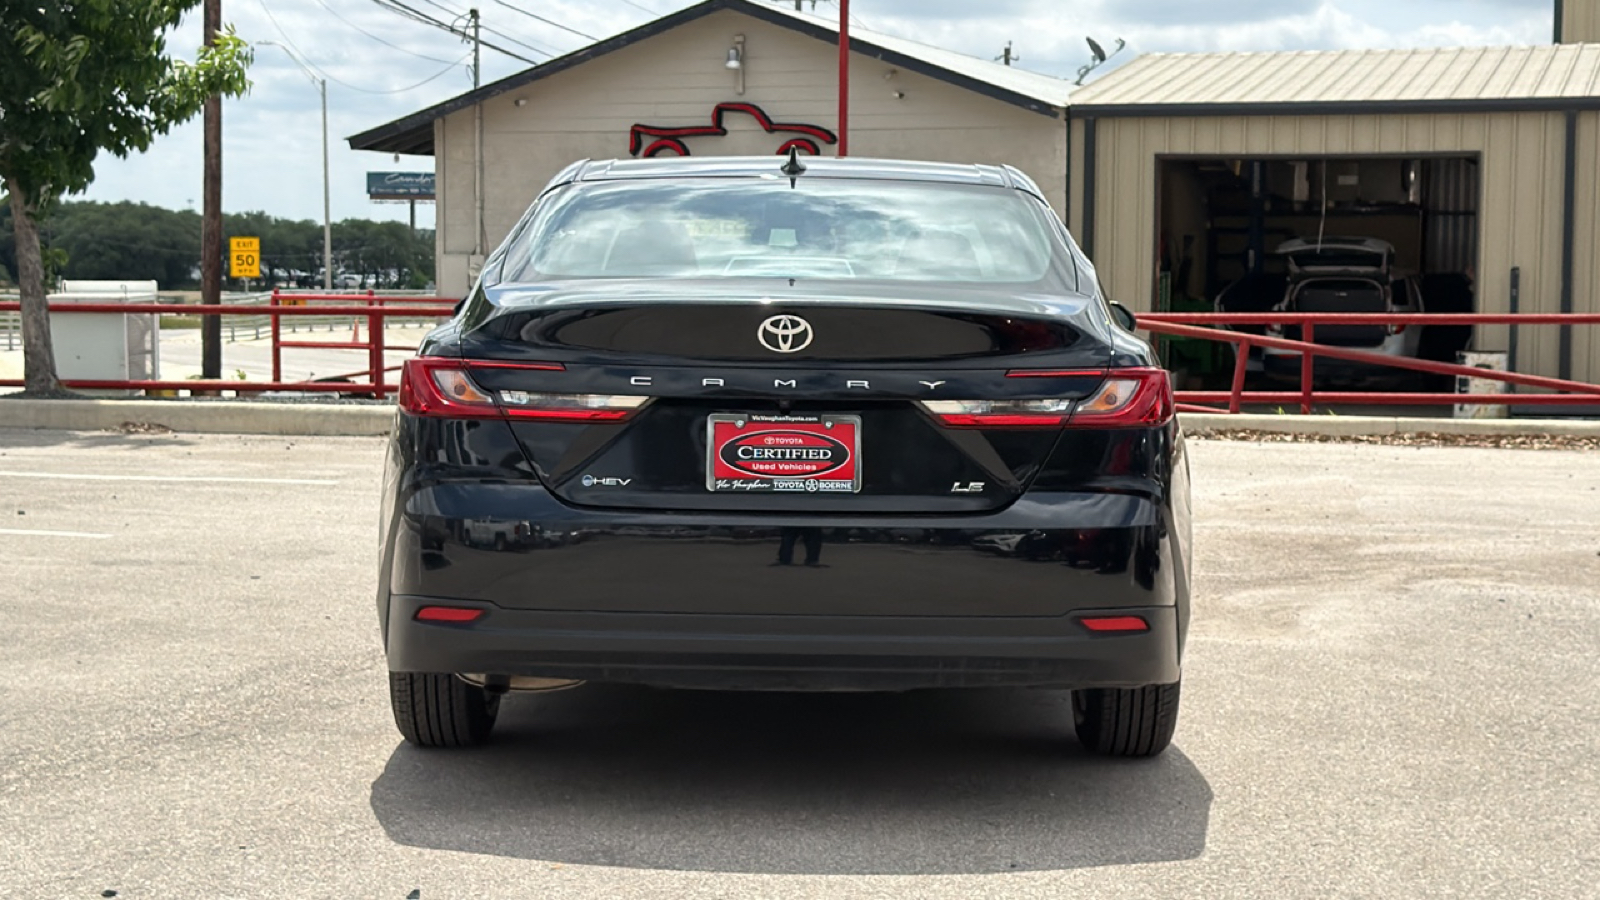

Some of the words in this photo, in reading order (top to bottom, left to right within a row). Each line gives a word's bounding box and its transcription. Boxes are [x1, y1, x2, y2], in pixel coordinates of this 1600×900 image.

[236, 254, 254, 266] 50
[630, 375, 946, 390] CAMRY
[752, 463, 776, 471] Used
[778, 463, 817, 471] Vehicles
[593, 476, 632, 486] HEV
[773, 481, 805, 489] TOYOTA
[819, 481, 853, 490] BOERNE
[950, 481, 986, 492] LE
